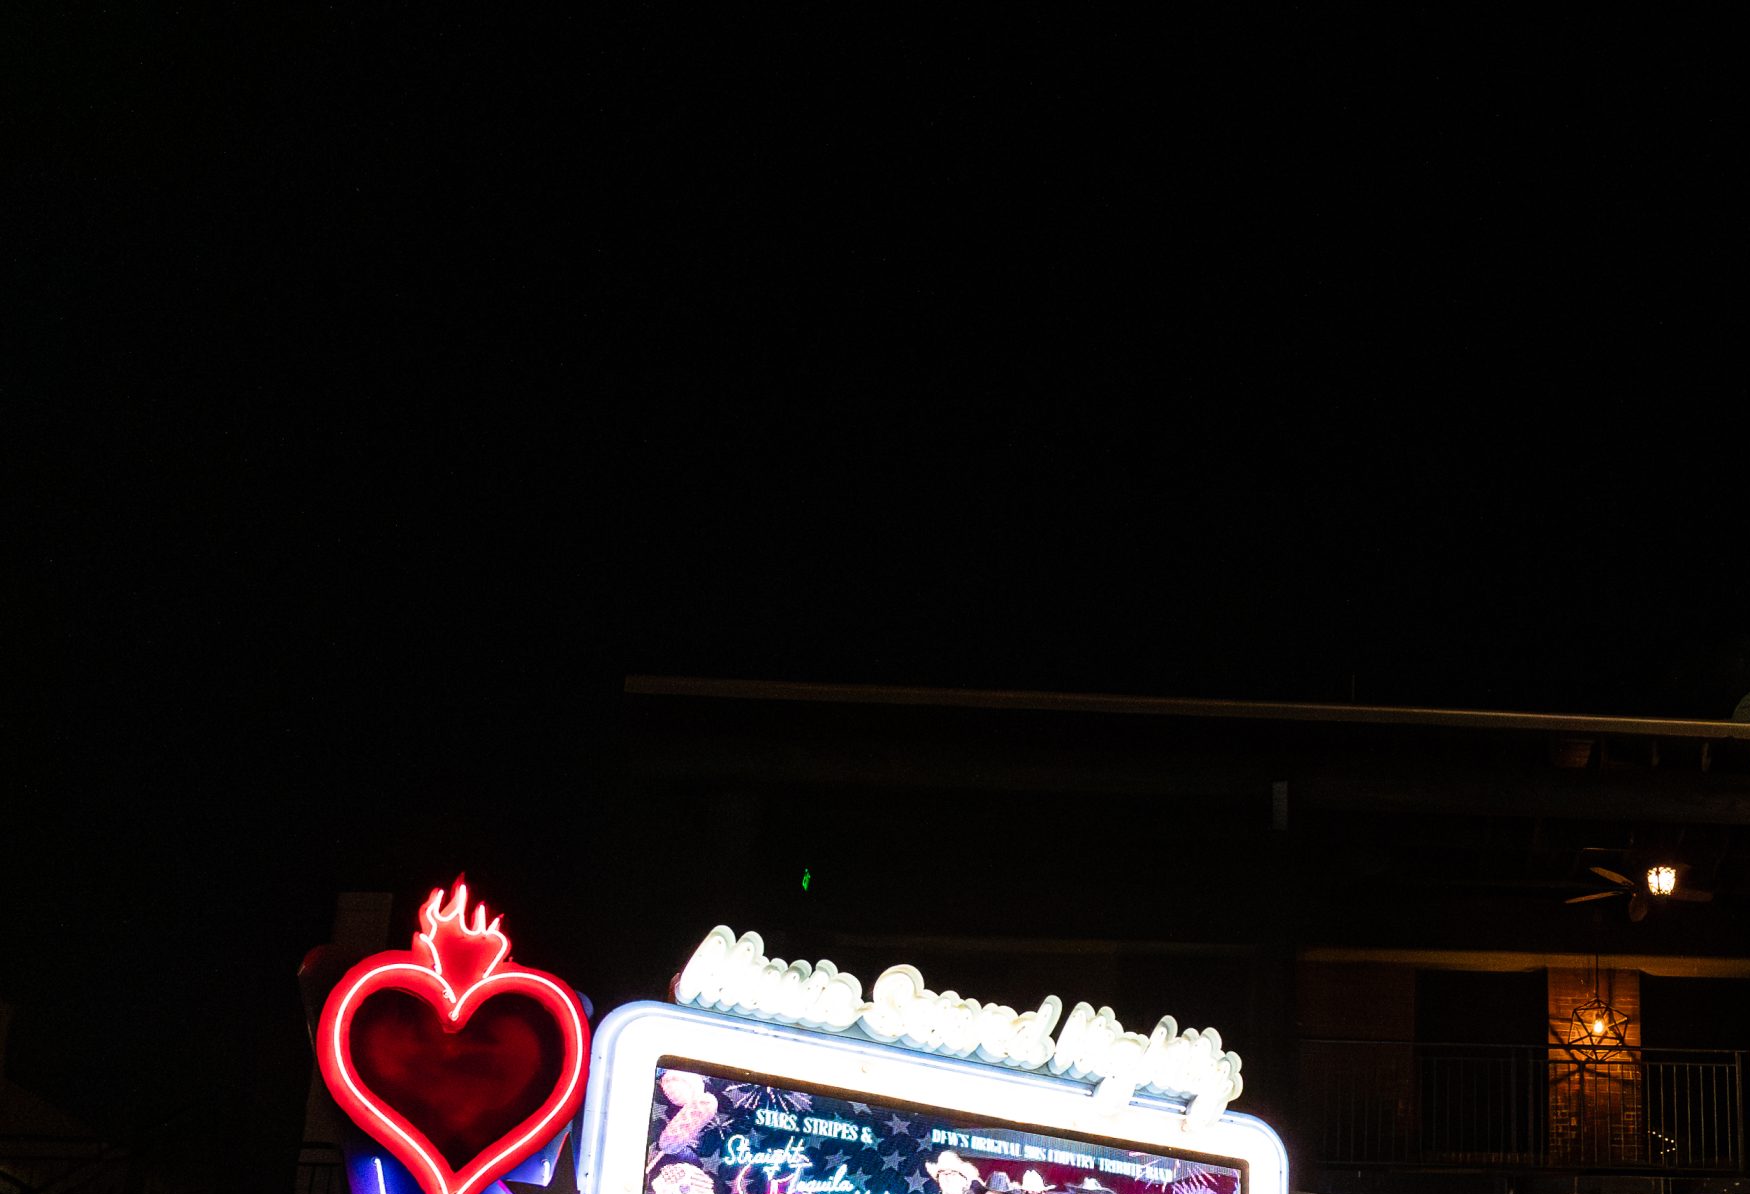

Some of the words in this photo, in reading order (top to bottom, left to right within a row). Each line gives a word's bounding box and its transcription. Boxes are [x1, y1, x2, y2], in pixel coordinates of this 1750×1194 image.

[803, 1116, 858, 1141] STRIPES
[860, 1127, 874, 1143] &
[932, 1128, 969, 1147] DFW'S
[971, 1135, 1021, 1158] ORIGINAL
[1047, 1149, 1096, 1169] COUNTRY
[724, 1134, 809, 1178] Straight
